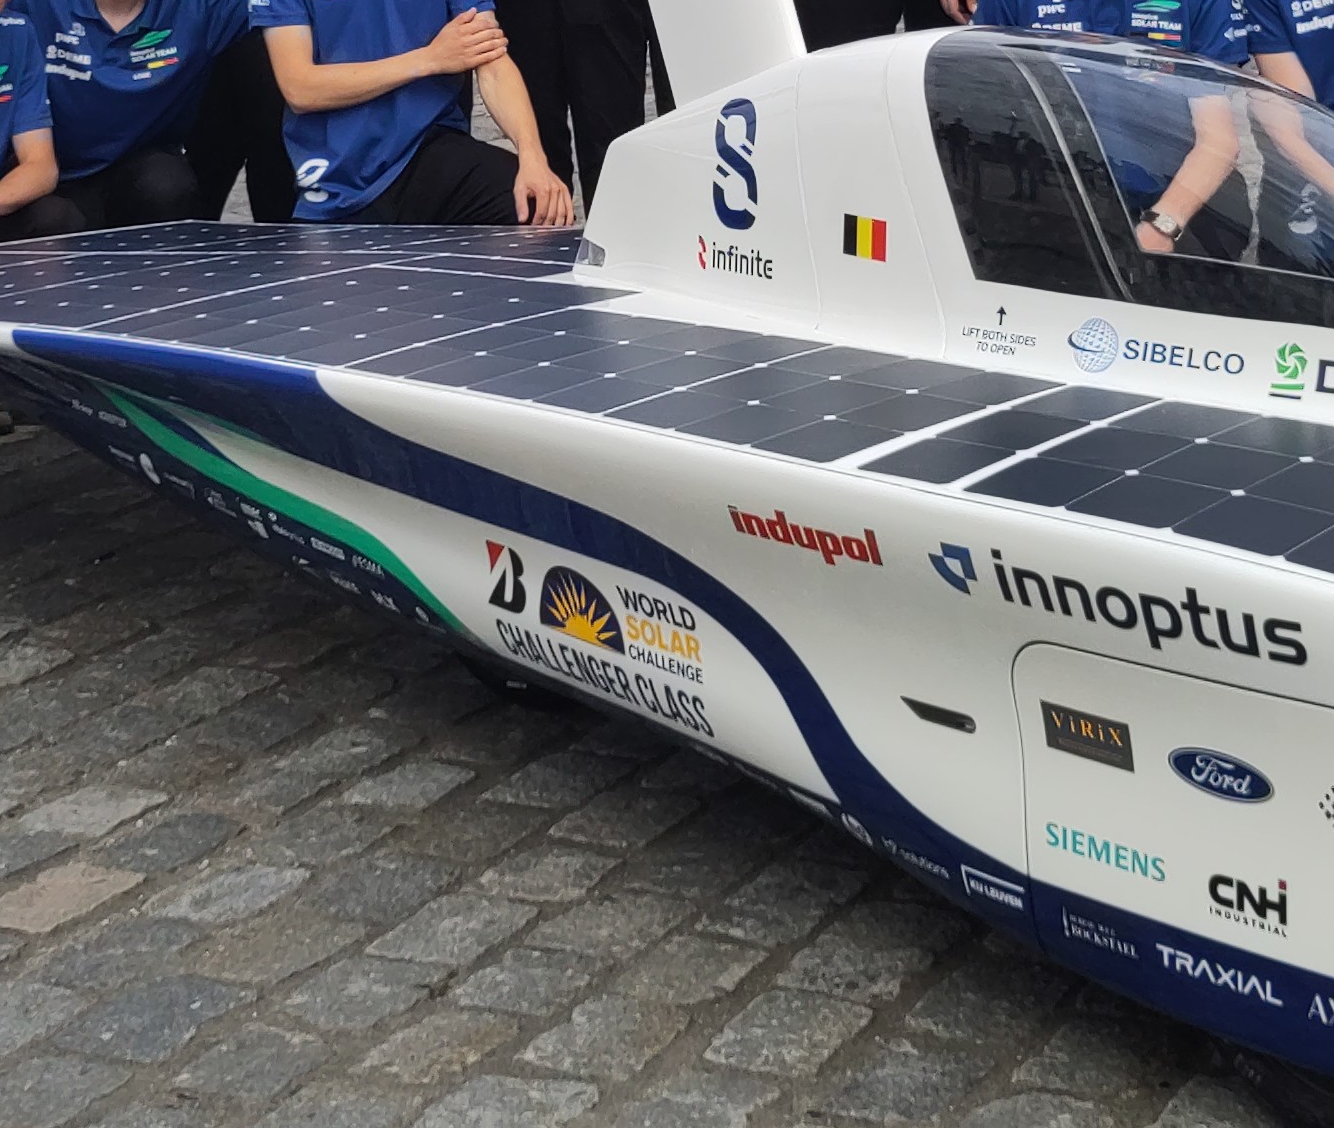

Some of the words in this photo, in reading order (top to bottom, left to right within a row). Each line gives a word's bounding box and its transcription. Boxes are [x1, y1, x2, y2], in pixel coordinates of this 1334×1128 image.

[1037, 3, 1066, 18] pwc
[1158, 21, 1182, 30] TEAM
[712, 242, 773, 279] infinite
[962, 326, 981, 337] LIFT
[982, 329, 1007, 342] BOTH
[1010, 333, 1037, 346] SIDES
[977, 341, 989, 352] TO
[990, 343, 1016, 355] OPEN
[1123, 339, 1245, 374] SIBELCO
[727, 505, 883, 566] indupol
[616, 585, 696, 631] WORLD
[990, 548, 1308, 666] innoptus
[625, 615, 703, 663] SOLAR
[496, 618, 640, 706] CHALLENGER
[634, 673, 715, 738] CLASS
[628, 643, 704, 684] CHALLENGE
[1191, 755, 1251, 795] Ford
[1046, 822, 1166, 881] SIEMENS
[1208, 904, 1288, 938] INDUSTRIAL
[1155, 942, 1283, 1007] TRAXIAL
